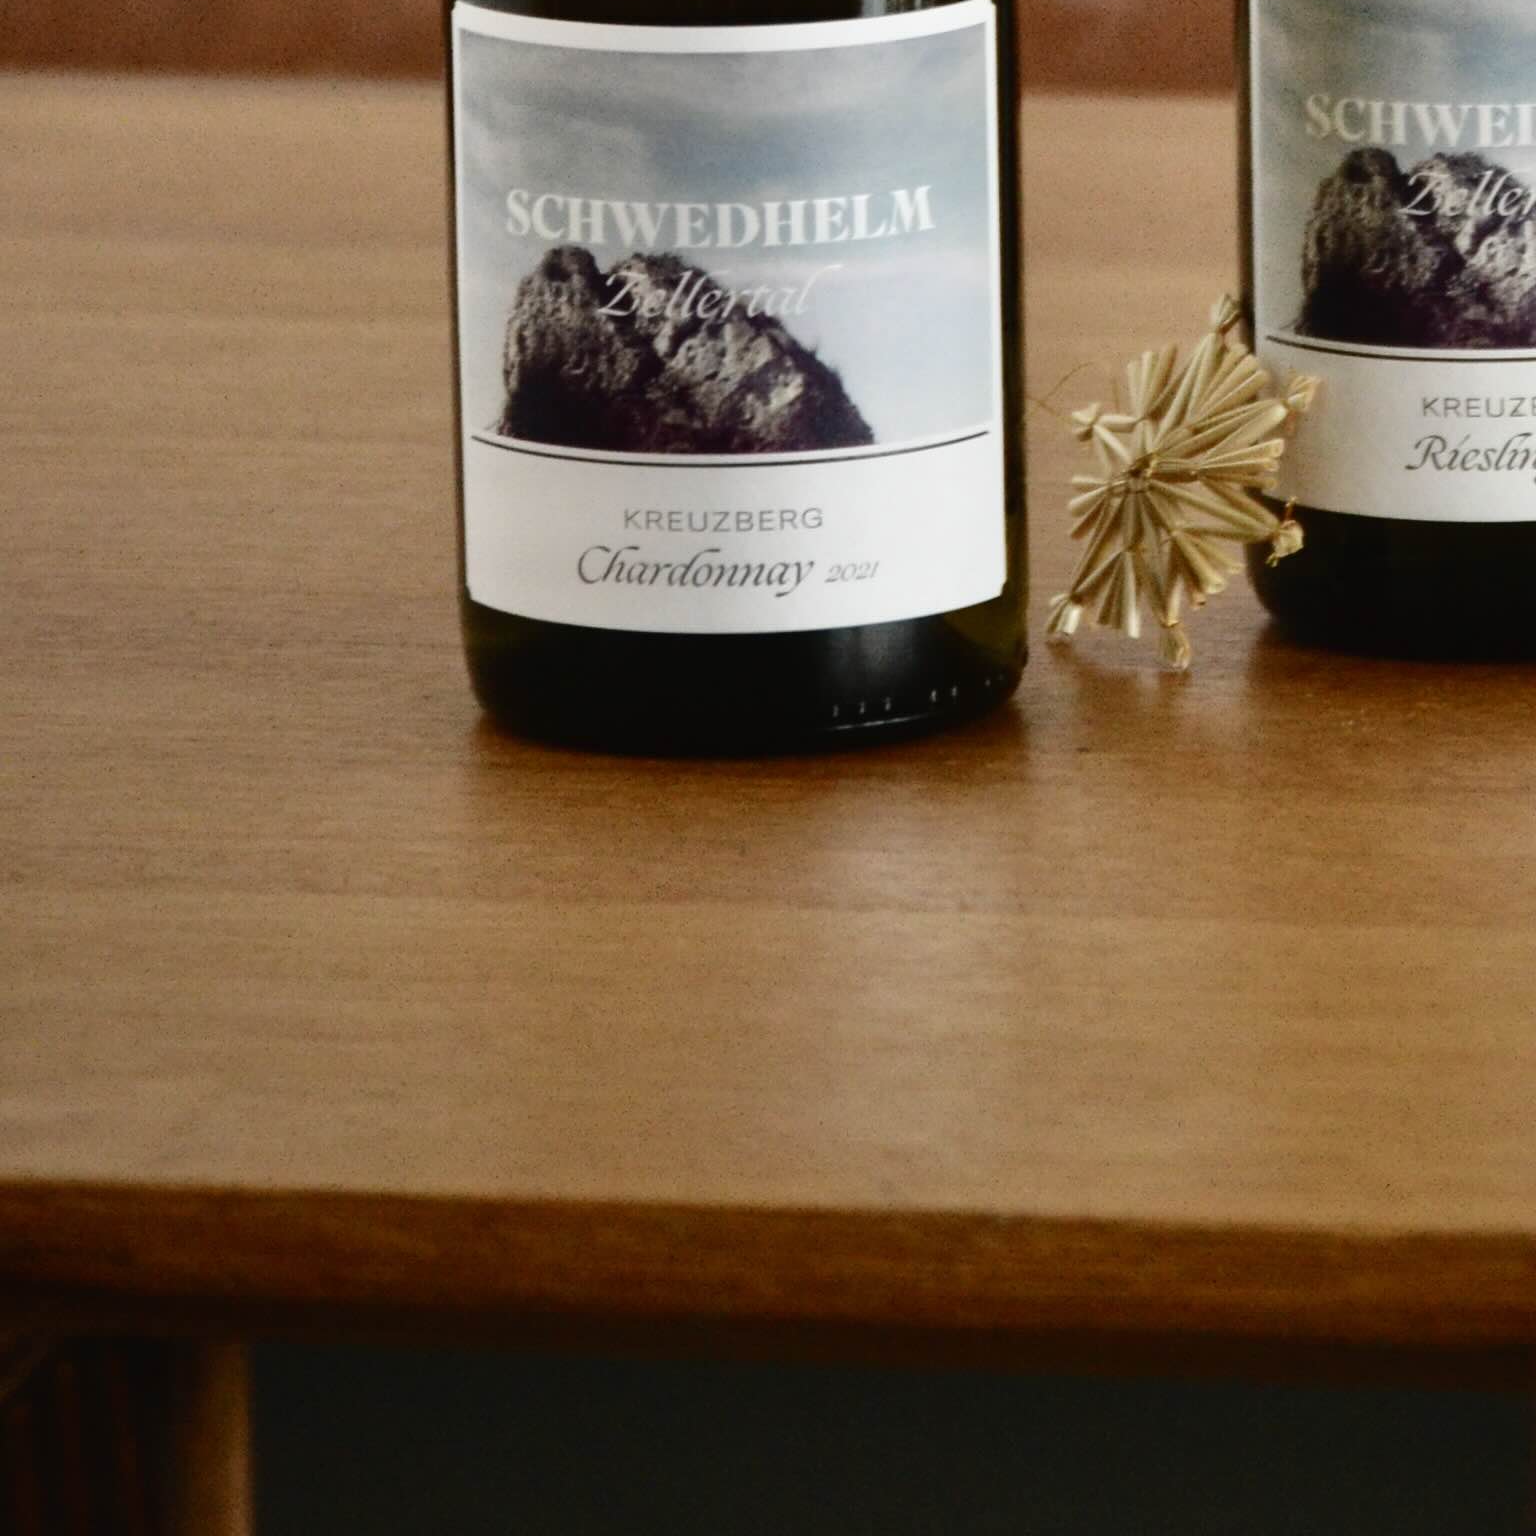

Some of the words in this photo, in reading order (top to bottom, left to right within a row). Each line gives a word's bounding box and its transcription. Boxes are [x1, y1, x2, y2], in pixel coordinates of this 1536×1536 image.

[505, 184, 936, 249] SCHWEDHELM
[598, 263, 845, 322] Zellertal
[623, 506, 824, 533] KREUZBERG
[576, 544, 815, 598] Chardonnay
[823, 559, 880, 584] 2021
